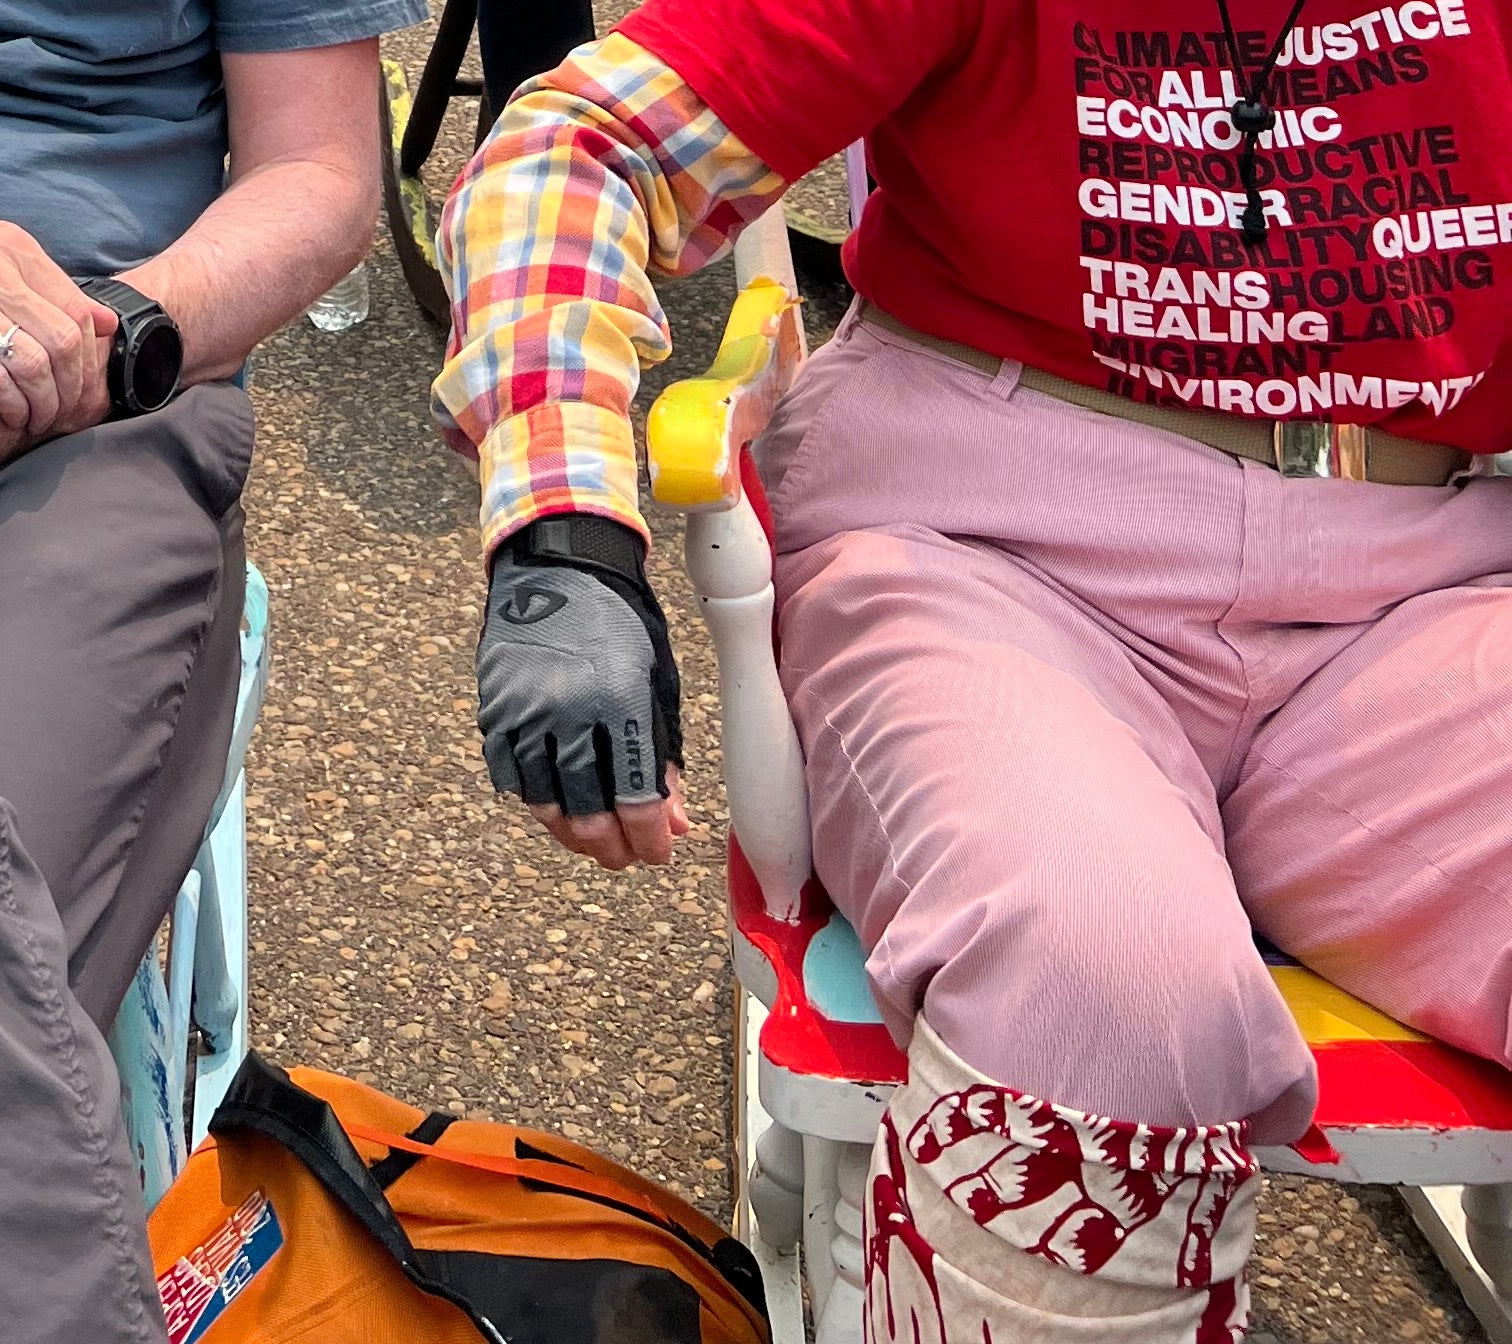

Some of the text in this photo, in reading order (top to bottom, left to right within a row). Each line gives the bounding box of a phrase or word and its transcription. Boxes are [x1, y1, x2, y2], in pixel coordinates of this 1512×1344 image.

[1073, 20, 1267, 68] CLIMATE
[1074, 44, 1431, 109] FOR ALL MEANS
[1079, 126, 1460, 189] REPRODUCTIVE
[1078, 169, 1470, 229] GENDER RACIAL
[1079, 250, 1493, 310] TRANS HOUSING
[1082, 293, 1456, 344] HEALING LAND
[204, 1217, 254, 1305] FESTIVAL
